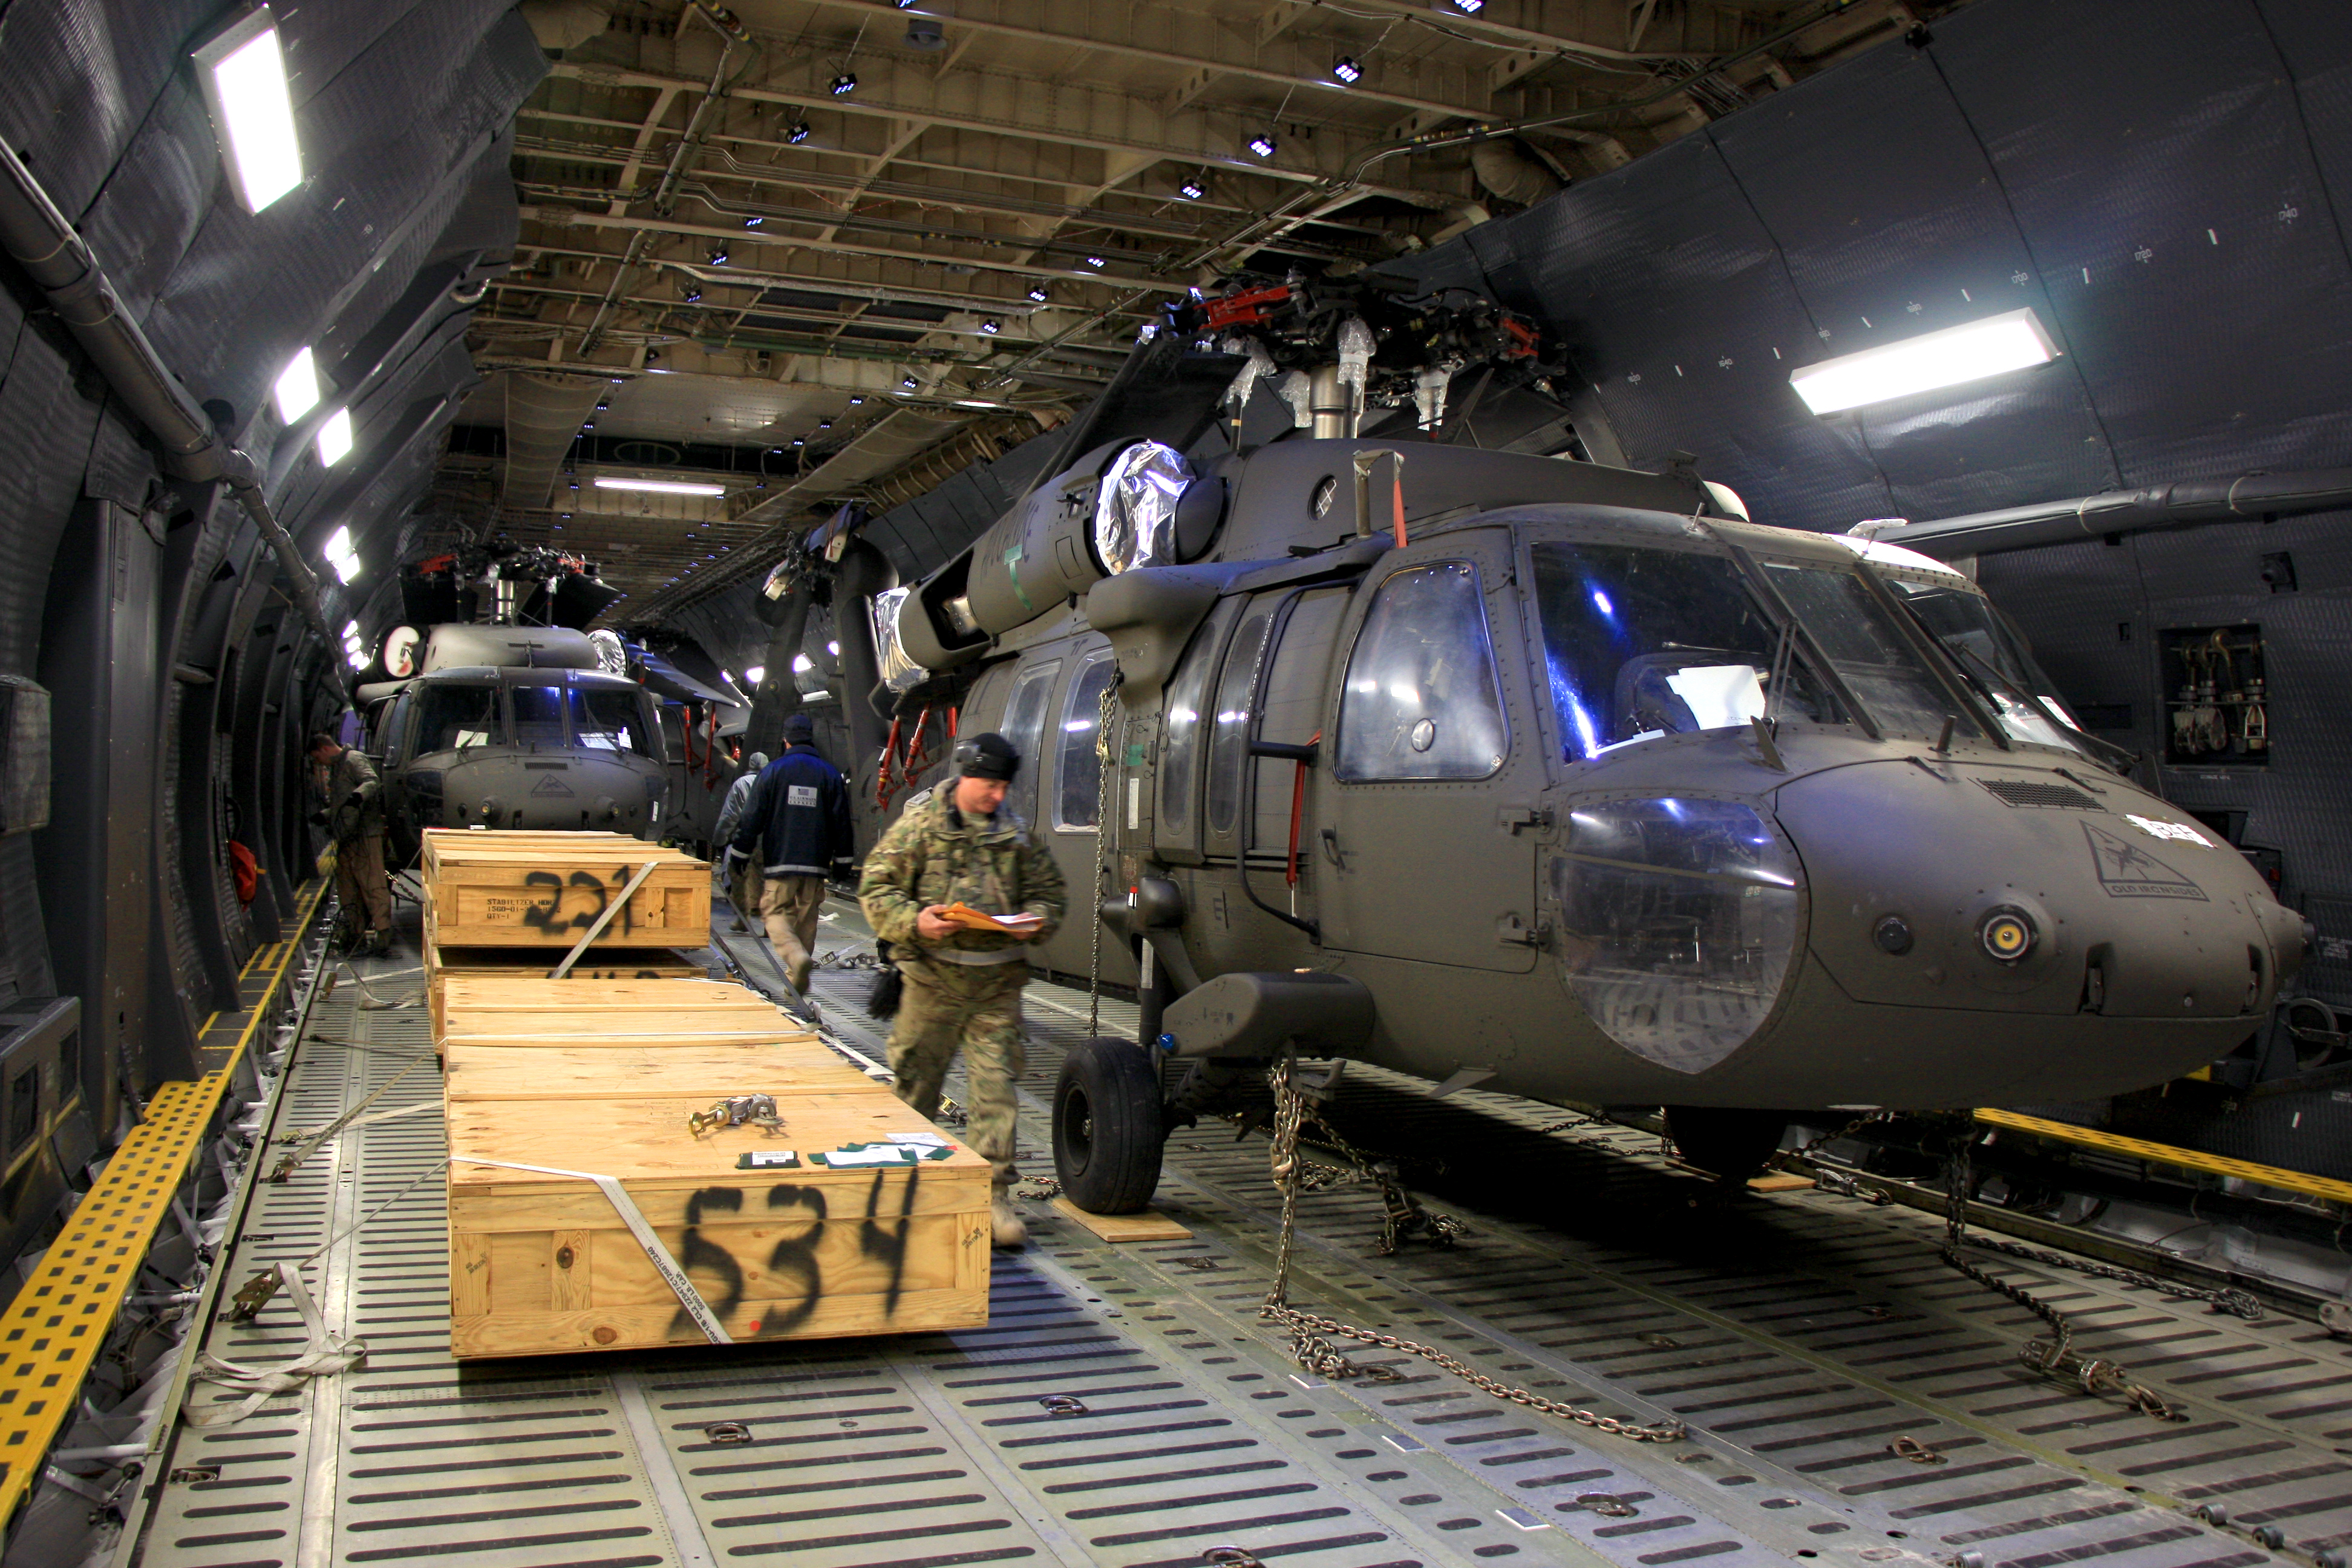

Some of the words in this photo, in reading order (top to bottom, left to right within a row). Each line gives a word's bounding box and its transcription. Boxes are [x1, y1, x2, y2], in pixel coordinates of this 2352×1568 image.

[2134, 249, 2152, 261] 1720
[2011, 272, 2028, 284] 1700
[2138, 886, 2201, 897] IRONSIDES
[693, 1295, 705, 1310] 5000
[691, 1305, 702, 1320] CL2
